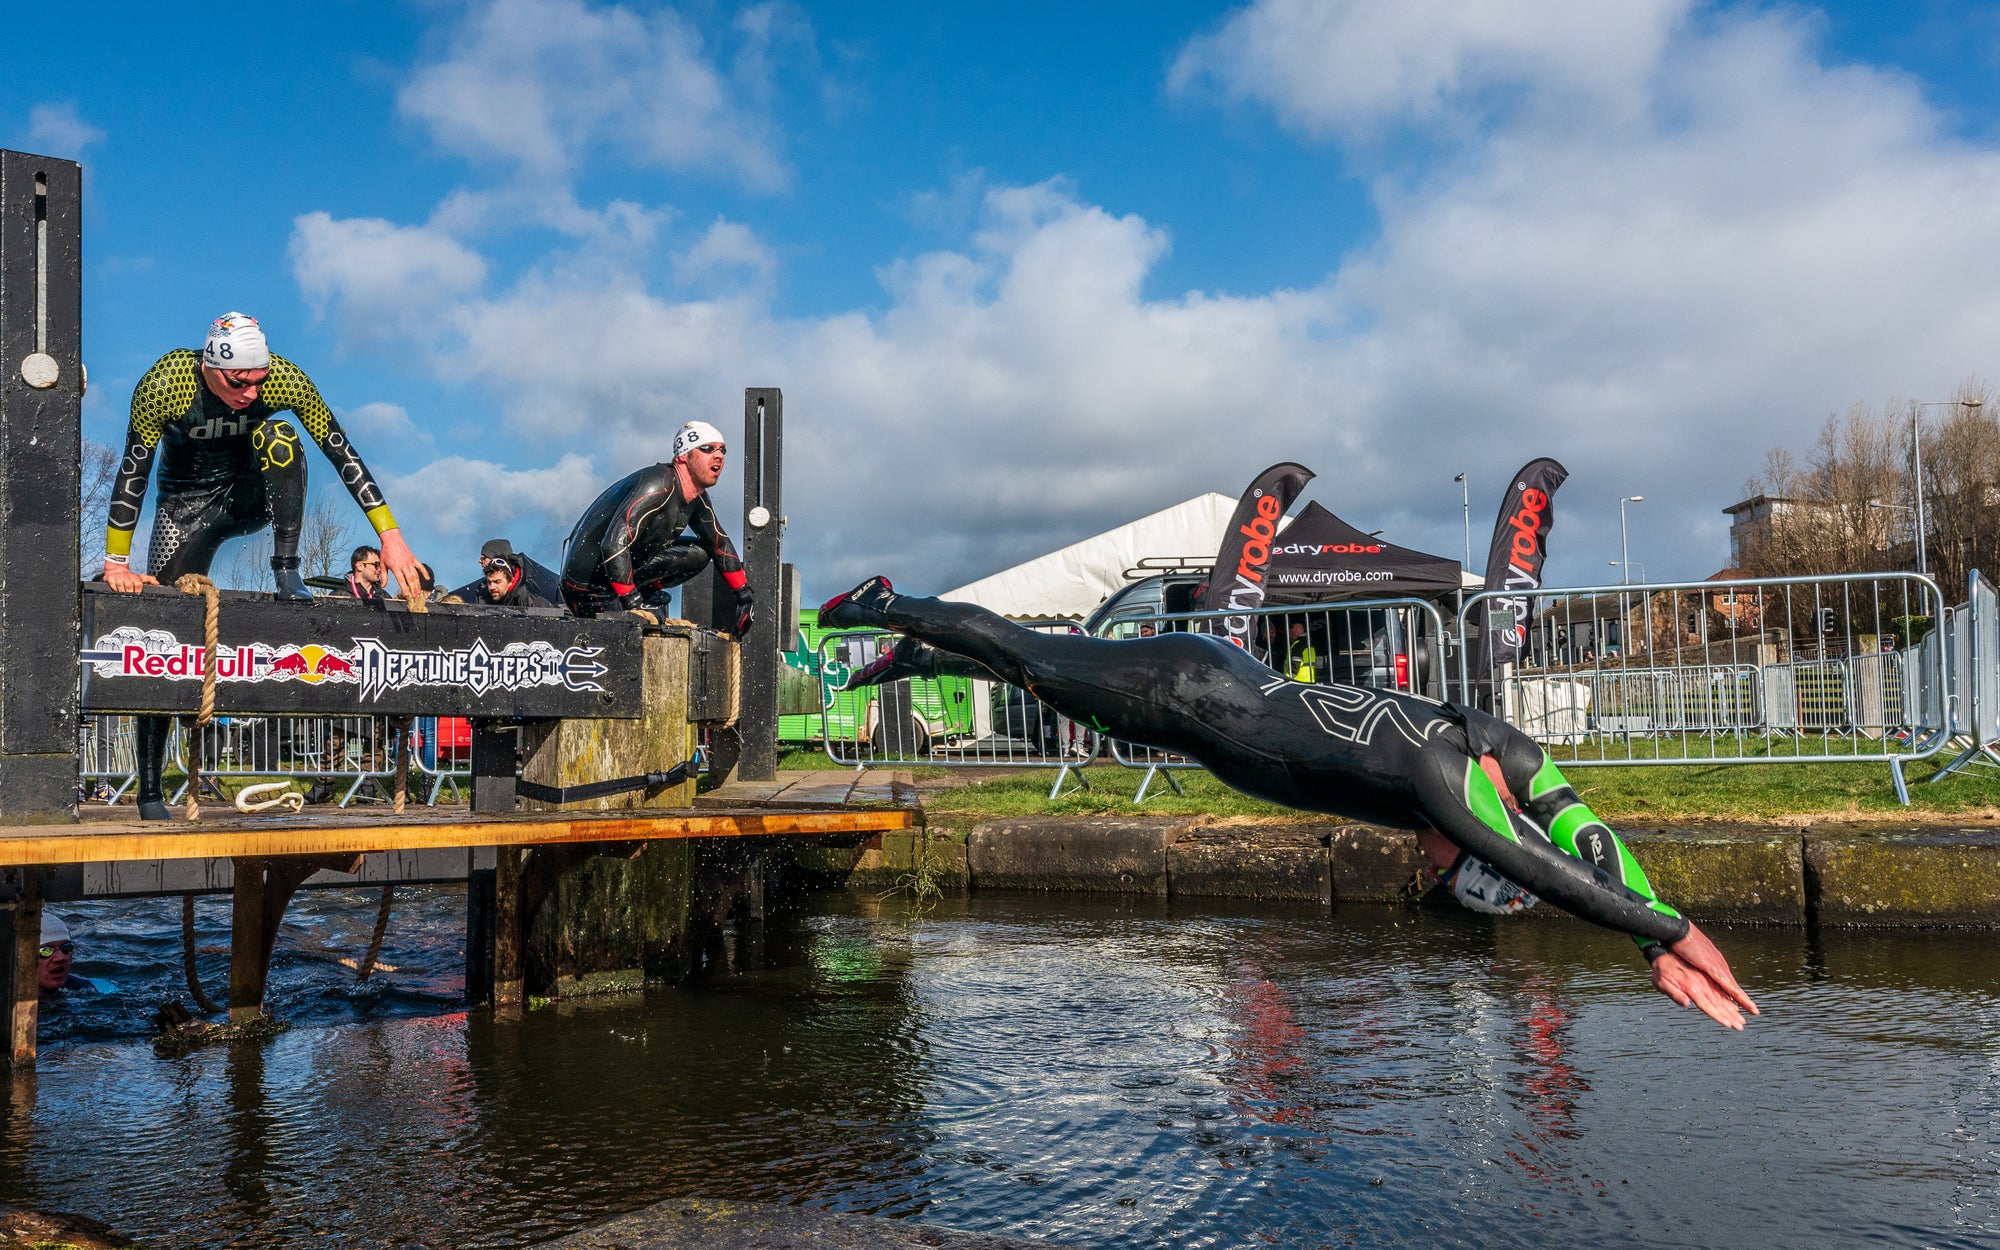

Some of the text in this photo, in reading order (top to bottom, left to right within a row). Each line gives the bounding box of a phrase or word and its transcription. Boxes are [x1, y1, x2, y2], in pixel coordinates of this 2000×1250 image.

[206, 340, 234, 360] 48
[676, 431, 699, 449] 38
[1284, 543, 1381, 556] dryrobe
[1279, 570, 1393, 585] www.dryrobe.com
[123, 645, 188, 676] Red
